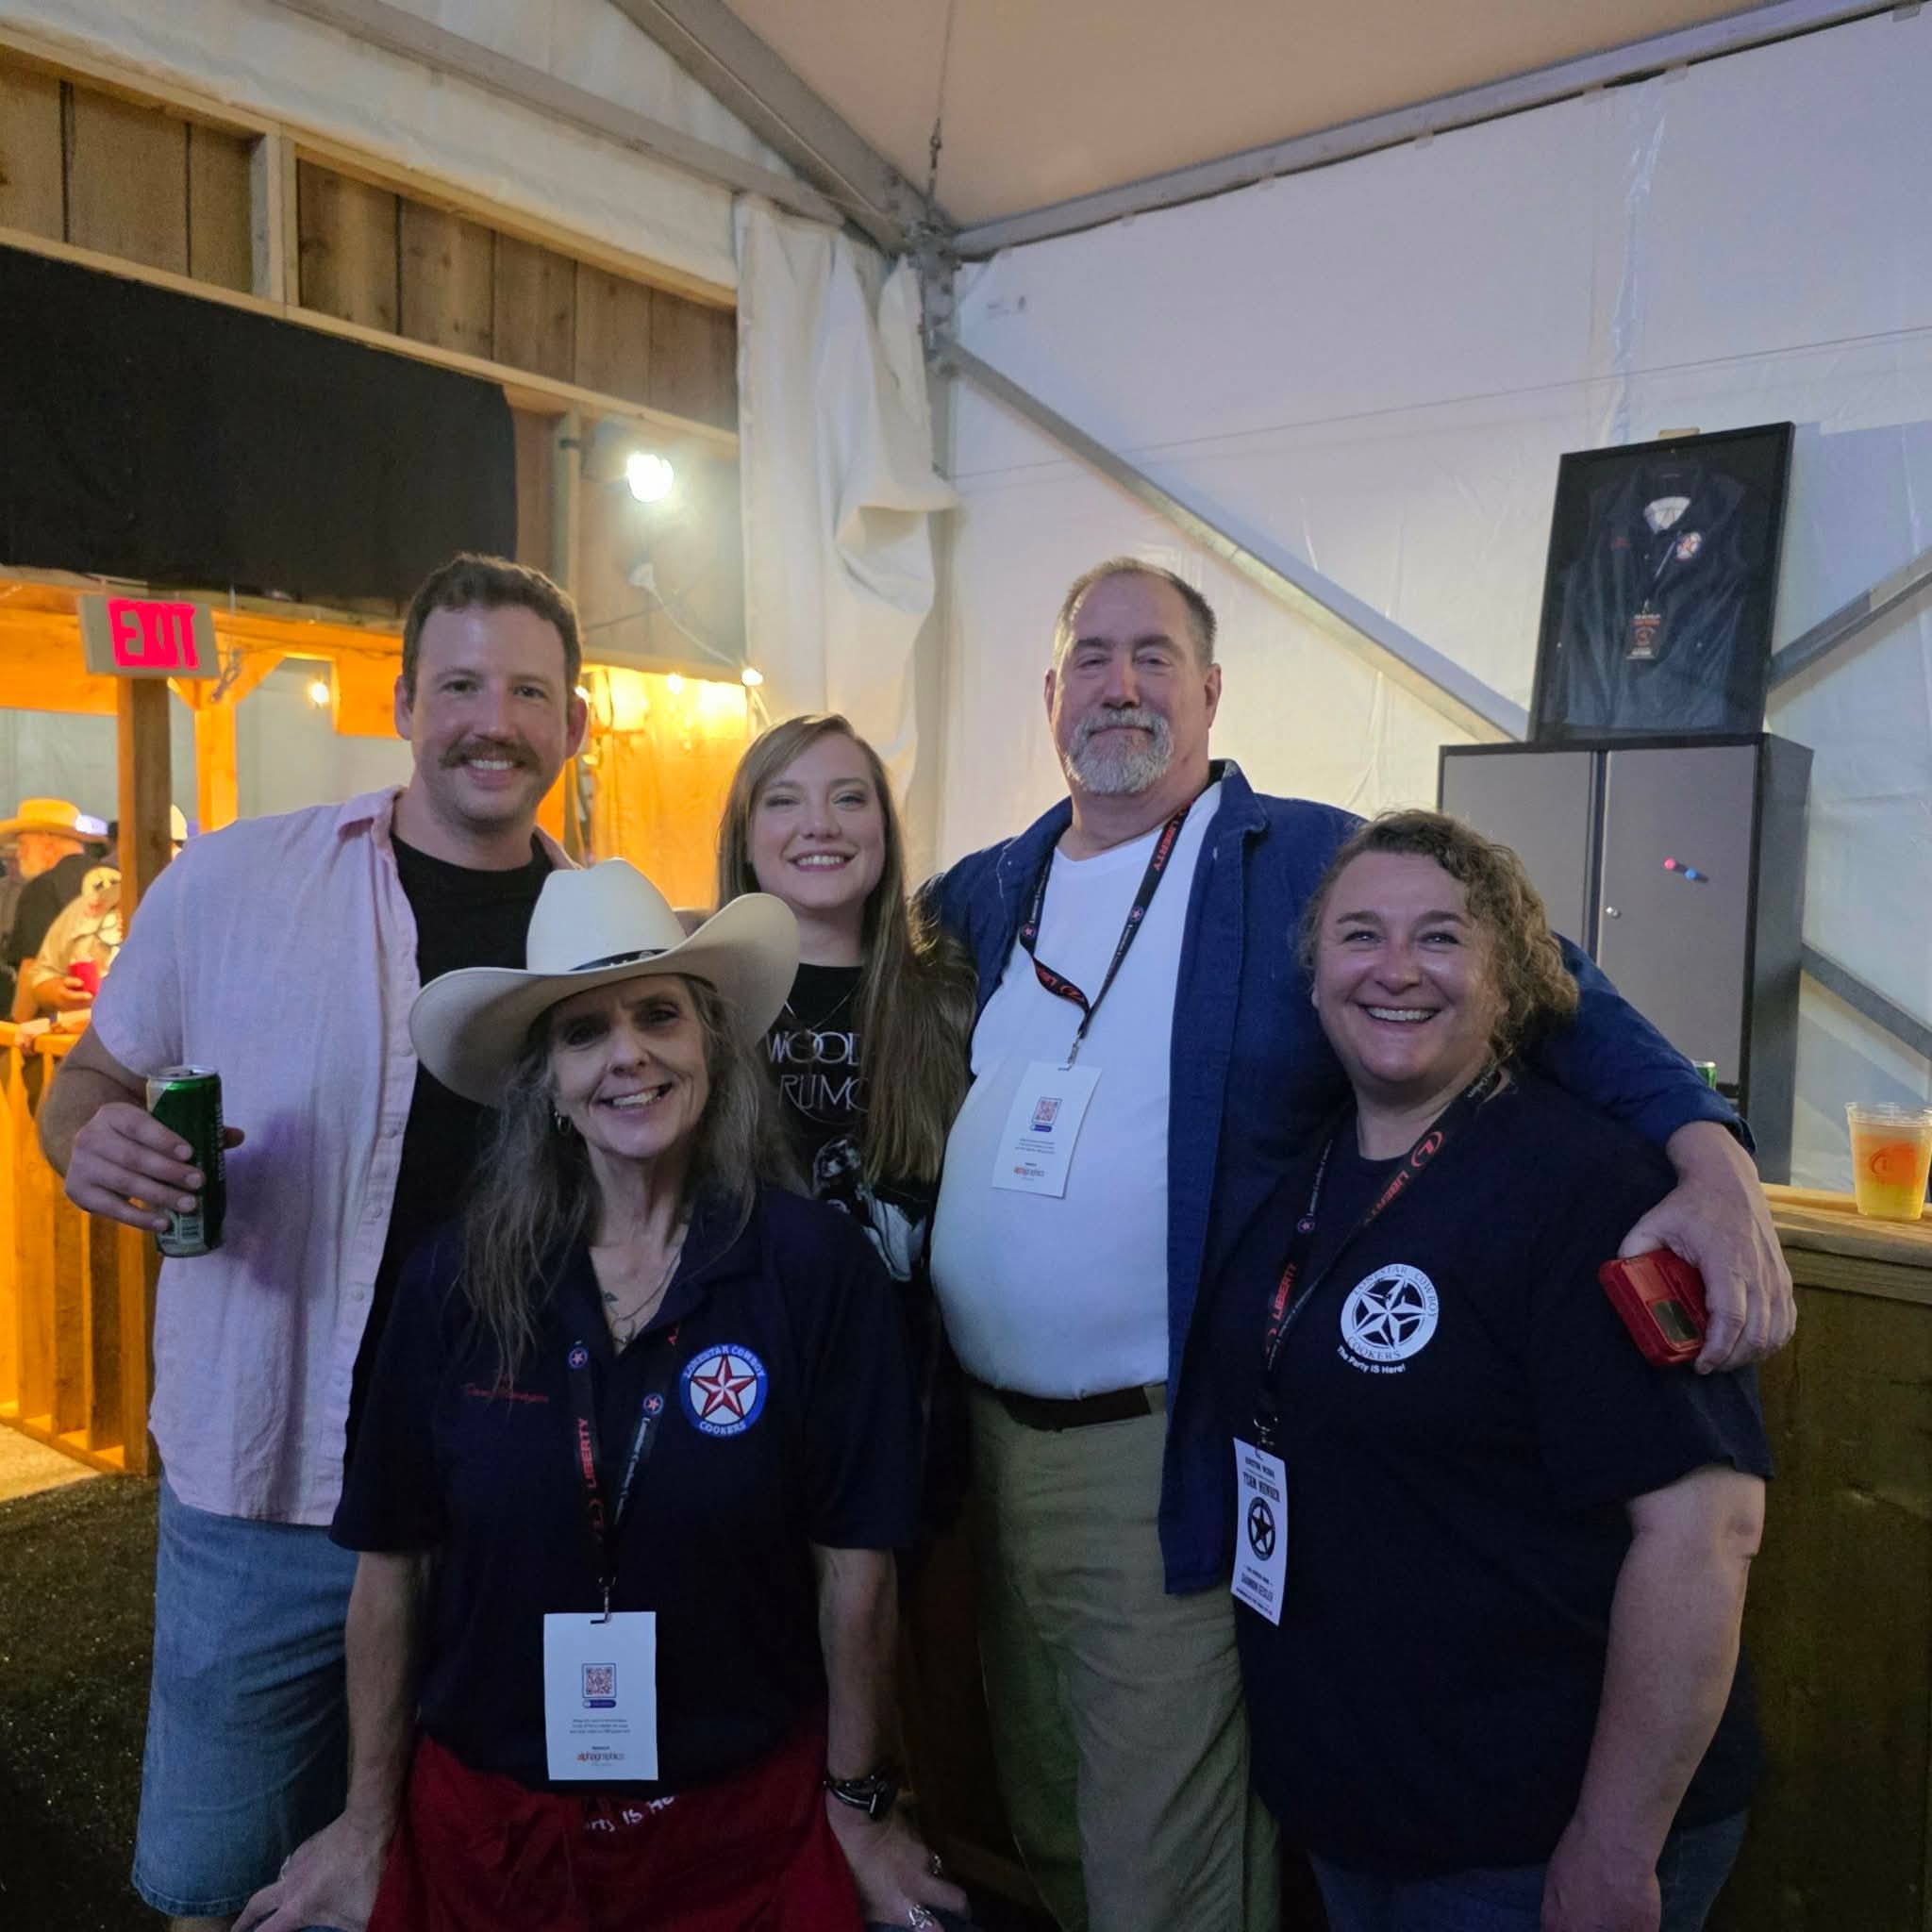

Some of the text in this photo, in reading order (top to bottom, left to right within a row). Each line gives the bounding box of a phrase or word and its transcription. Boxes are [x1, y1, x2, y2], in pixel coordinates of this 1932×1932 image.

[108, 596, 200, 671] EXIT
[1347, 1336, 1402, 1360] COOKERS
[699, 1421, 747, 1435] COOKERS
[576, 1417, 597, 1489] LIBERTY
